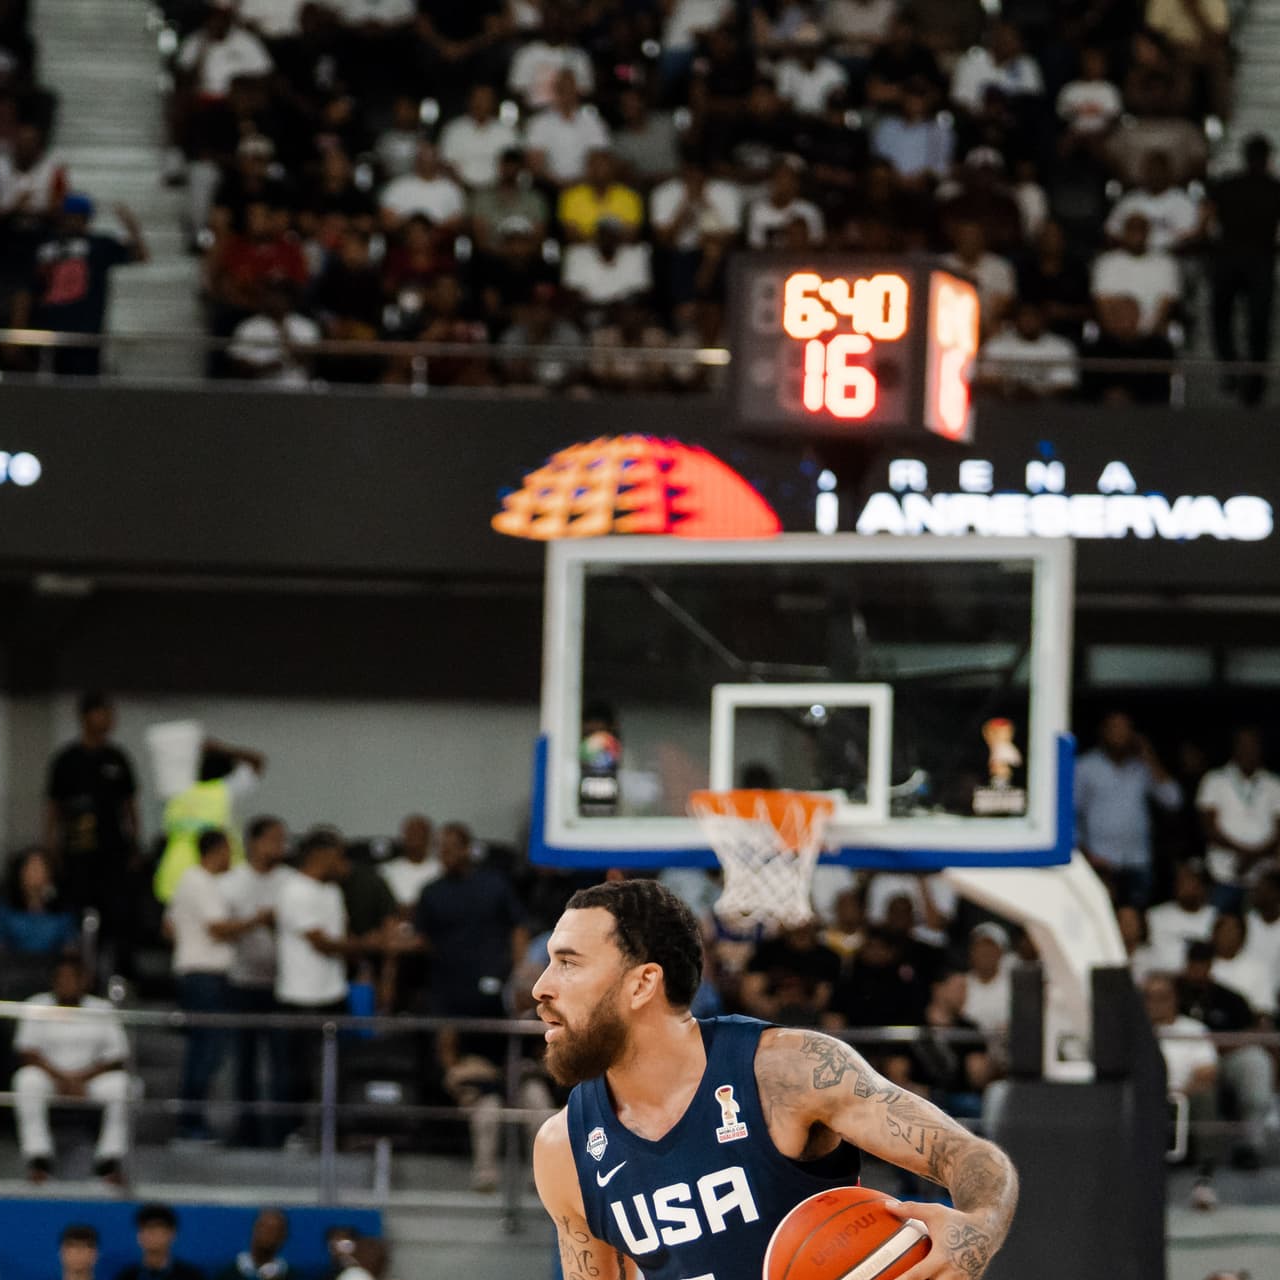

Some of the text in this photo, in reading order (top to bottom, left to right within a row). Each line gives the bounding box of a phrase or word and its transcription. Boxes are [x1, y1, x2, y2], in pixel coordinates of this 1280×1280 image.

[783, 273, 909, 341] 6:40
[803, 334, 877, 419] 16
[610, 1166, 760, 1255] USA
